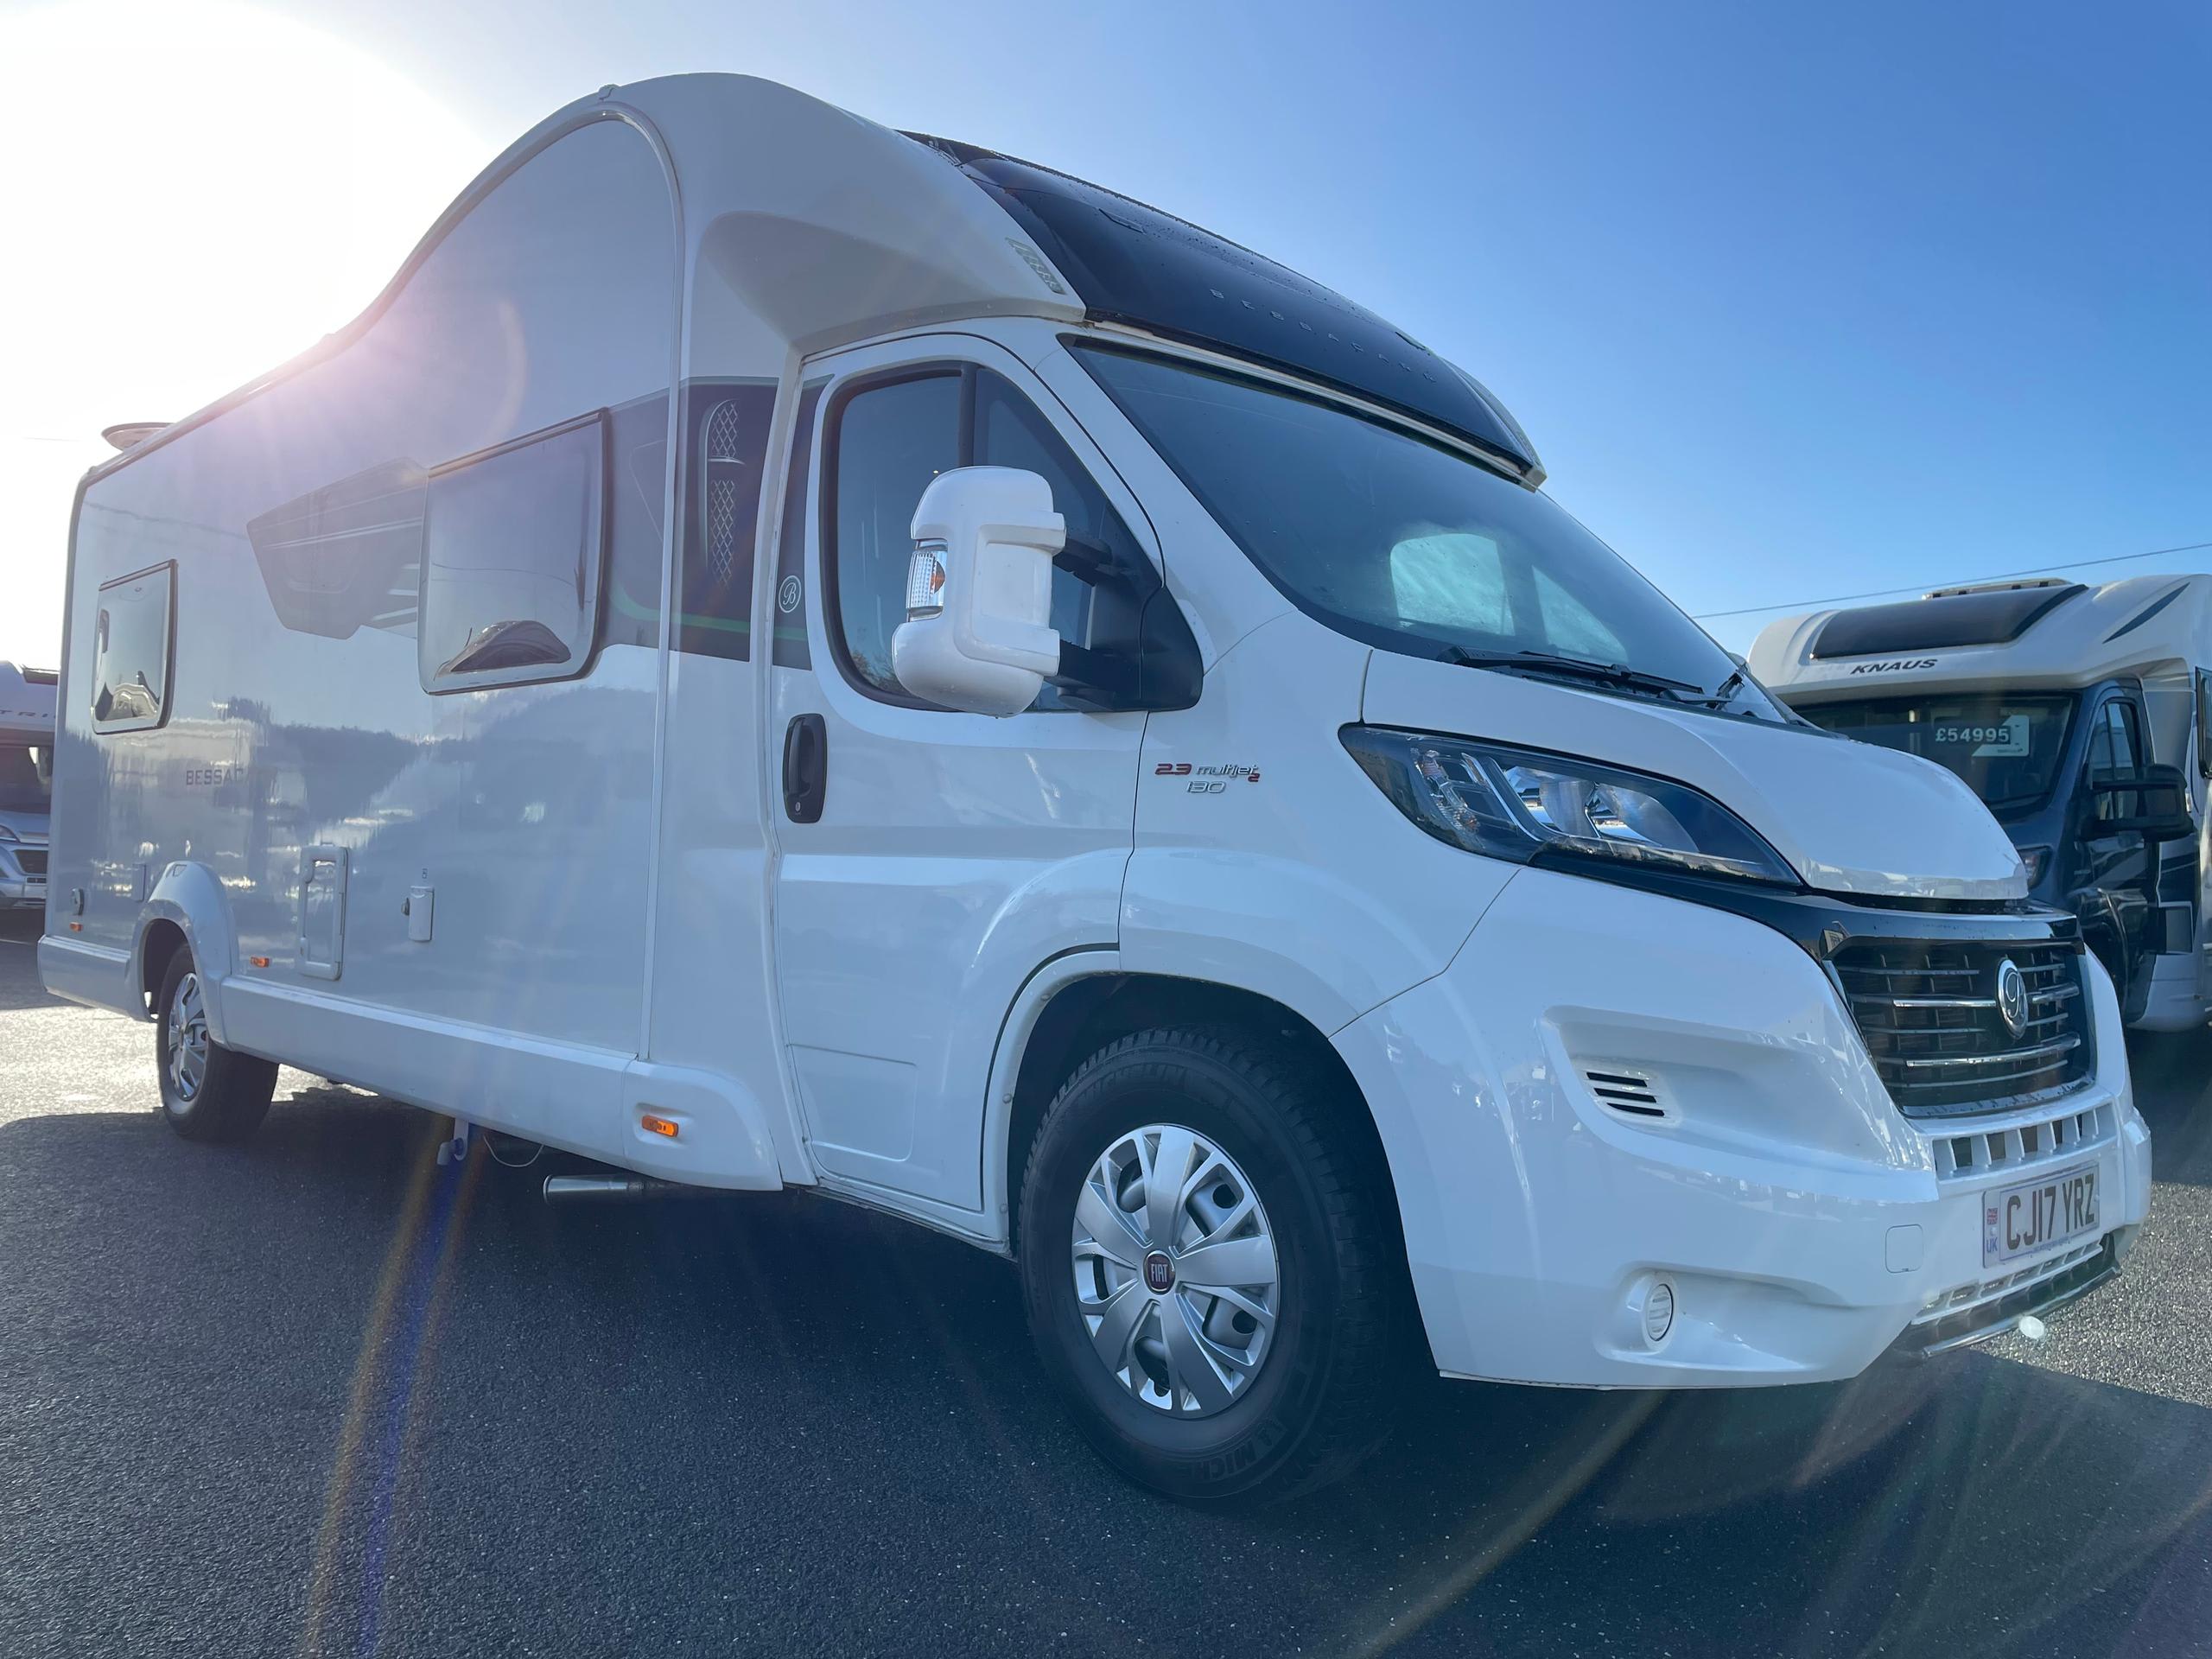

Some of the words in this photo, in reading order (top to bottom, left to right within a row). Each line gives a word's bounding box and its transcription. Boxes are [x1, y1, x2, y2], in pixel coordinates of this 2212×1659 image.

[1850, 658, 1938, 675] KNAUS
[1935, 728, 2010, 742] £54995
[1186, 780, 1227, 793] 130
[2006, 1185, 2056, 1250] CJ17
[2062, 1173, 2095, 1233] YRZ
[1986, 1236, 1999, 1253] UK
[1150, 1263, 1168, 1283] FIAT
